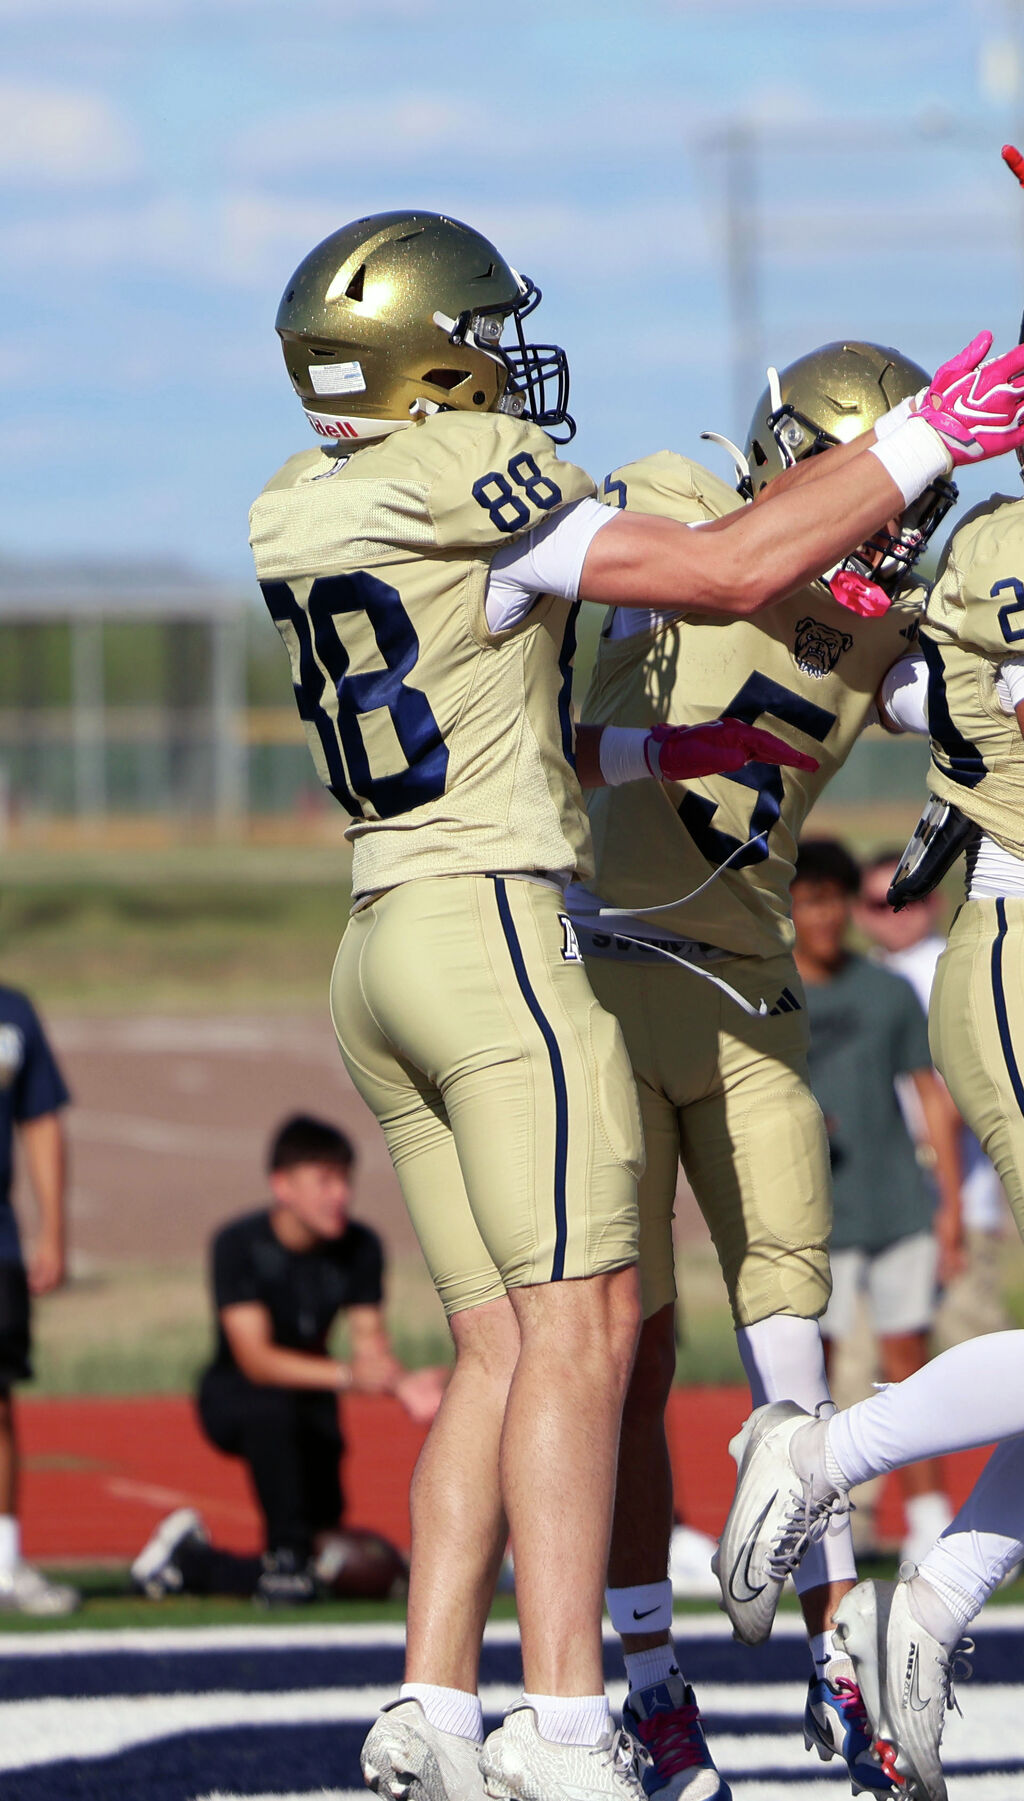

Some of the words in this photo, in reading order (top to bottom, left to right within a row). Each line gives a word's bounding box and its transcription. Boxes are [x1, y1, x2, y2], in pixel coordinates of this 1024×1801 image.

[472, 451, 562, 533] 88
[604, 464, 628, 510] 5
[677, 670, 837, 870] 5
[905, 1641, 916, 1680] AIR
[901, 1680, 912, 1710] ZOOM
